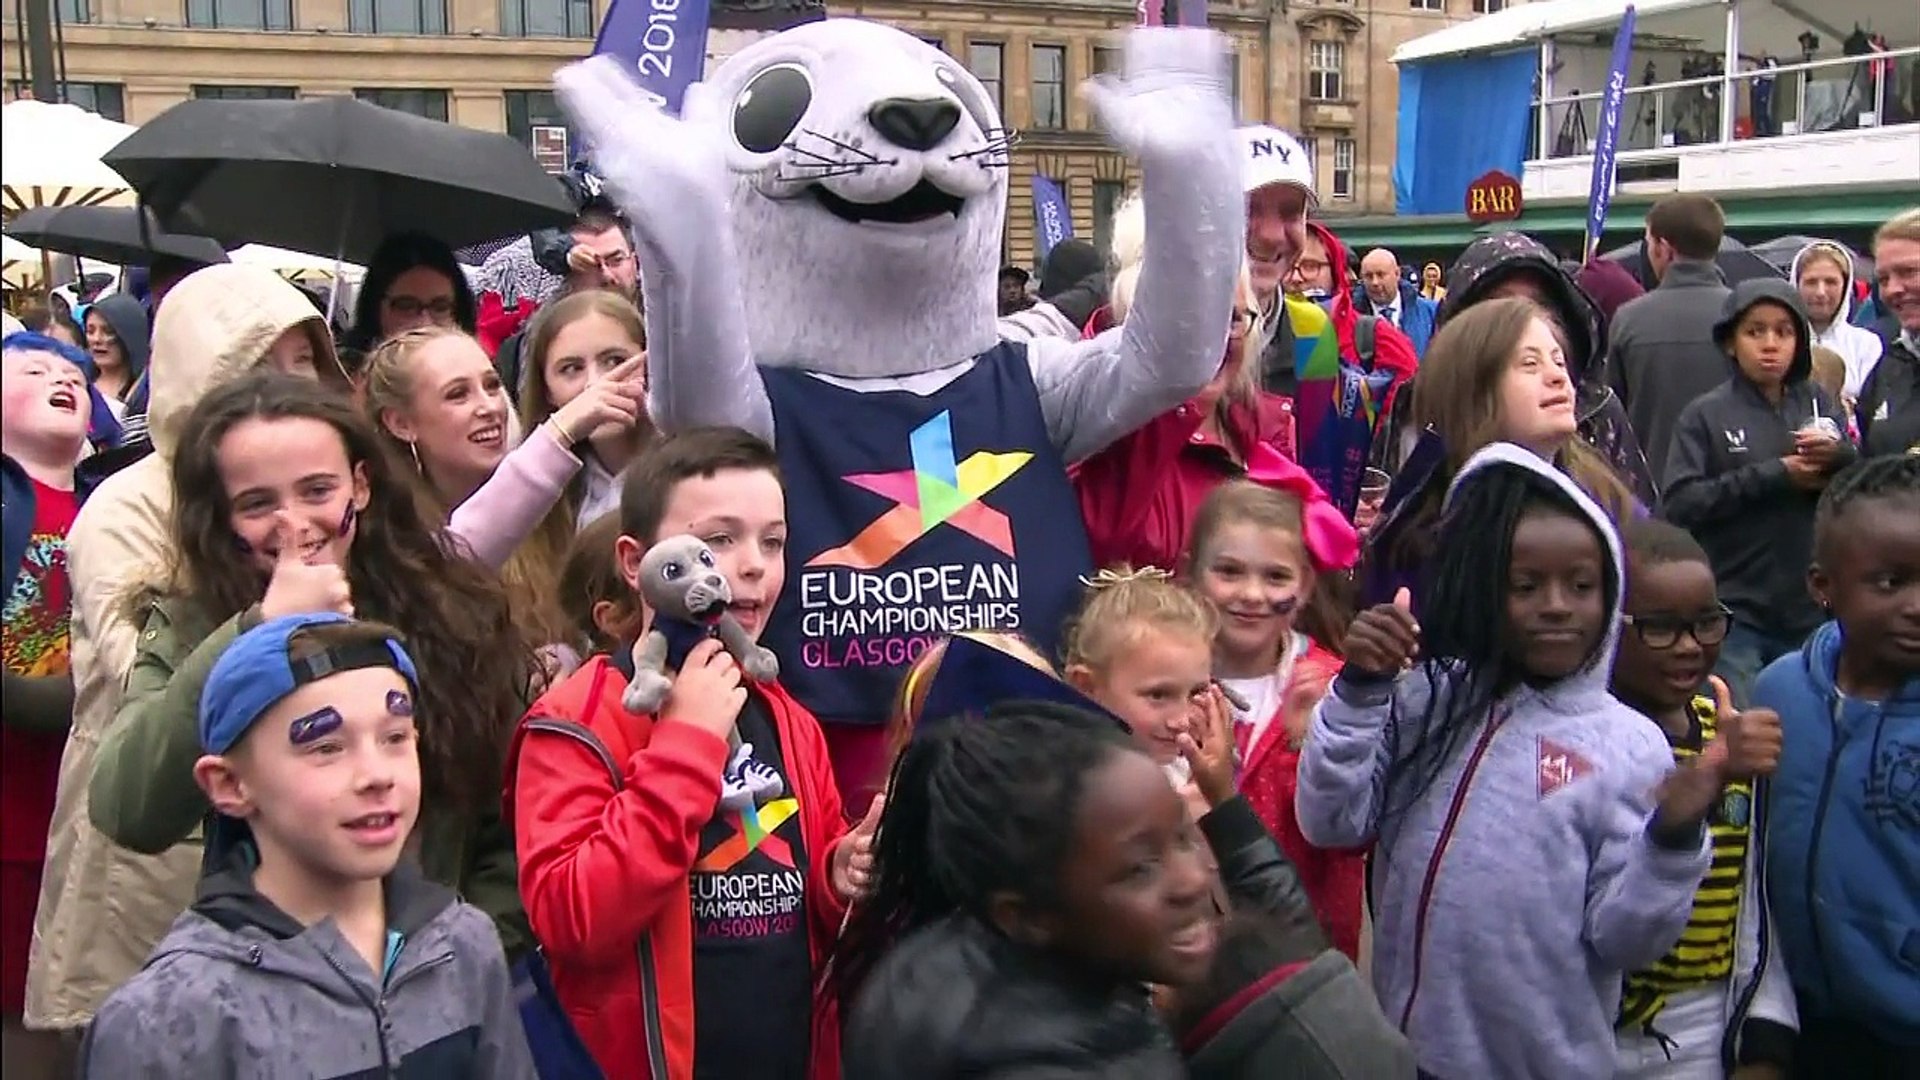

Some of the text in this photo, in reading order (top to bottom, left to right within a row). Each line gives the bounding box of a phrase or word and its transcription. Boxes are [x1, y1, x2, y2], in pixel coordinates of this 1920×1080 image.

[1249, 137, 1291, 165] NY
[1471, 185, 1515, 214] BAR
[801, 563, 1019, 609] EUROPEAN
[802, 603, 1020, 637] CHAMPIONSHIPS
[803, 636, 934, 668] GLASGO
[692, 896, 802, 919] HAMPIONSHIP
[706, 916, 768, 938] ASGOW
